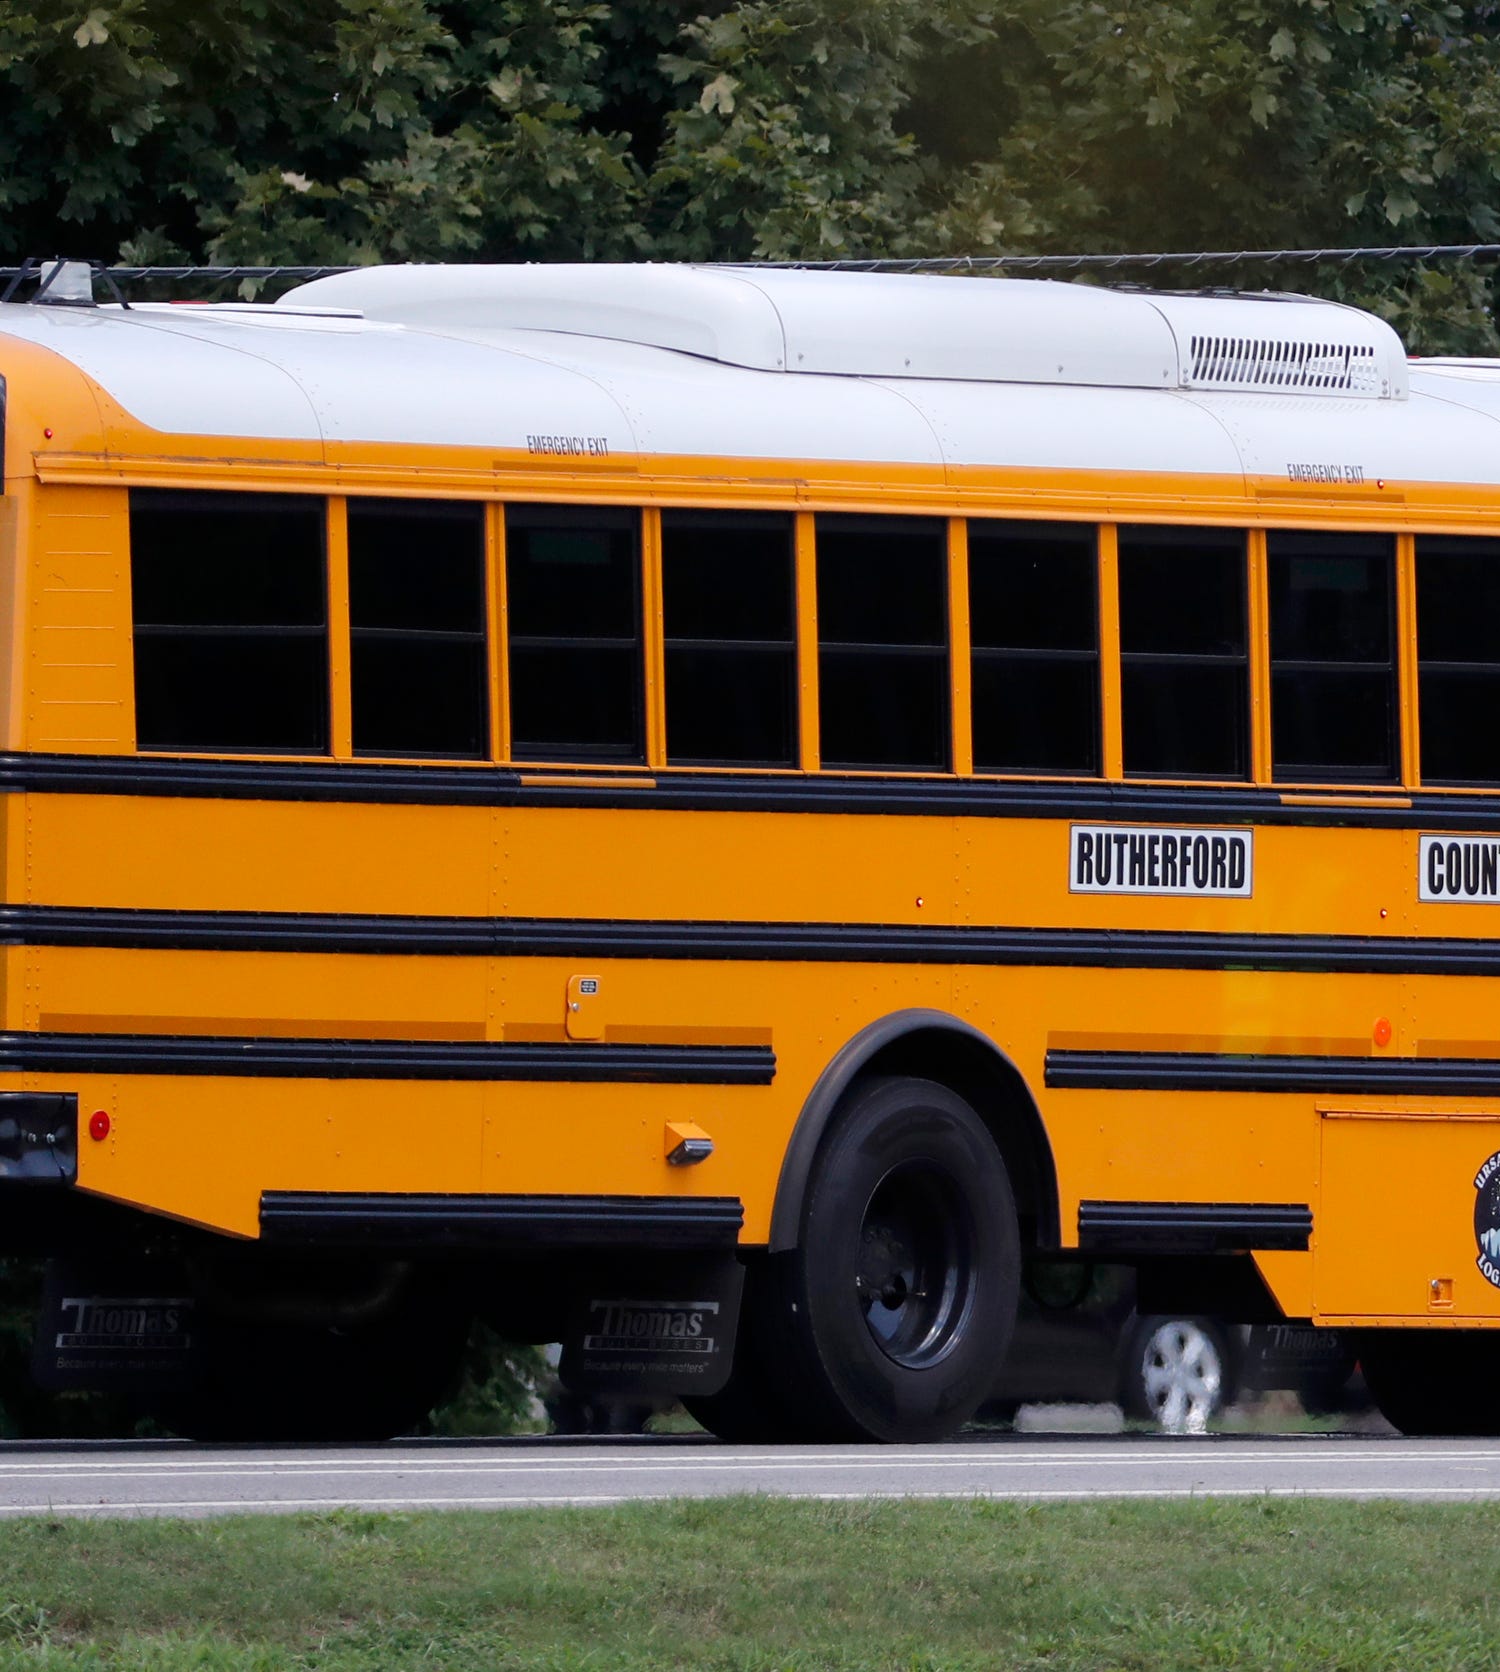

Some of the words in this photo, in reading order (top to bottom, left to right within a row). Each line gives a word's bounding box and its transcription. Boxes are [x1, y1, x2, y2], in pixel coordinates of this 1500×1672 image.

[526, 434, 585, 456] EMERGENCY
[587, 437, 609, 457] EXIT
[1286, 463, 1342, 483] EMERGENCY
[1344, 465, 1364, 484] EXIT
[1077, 832, 1246, 889] RUTHERFORD
[61, 1295, 195, 1334] Thomas
[590, 1298, 719, 1337] Thomas
